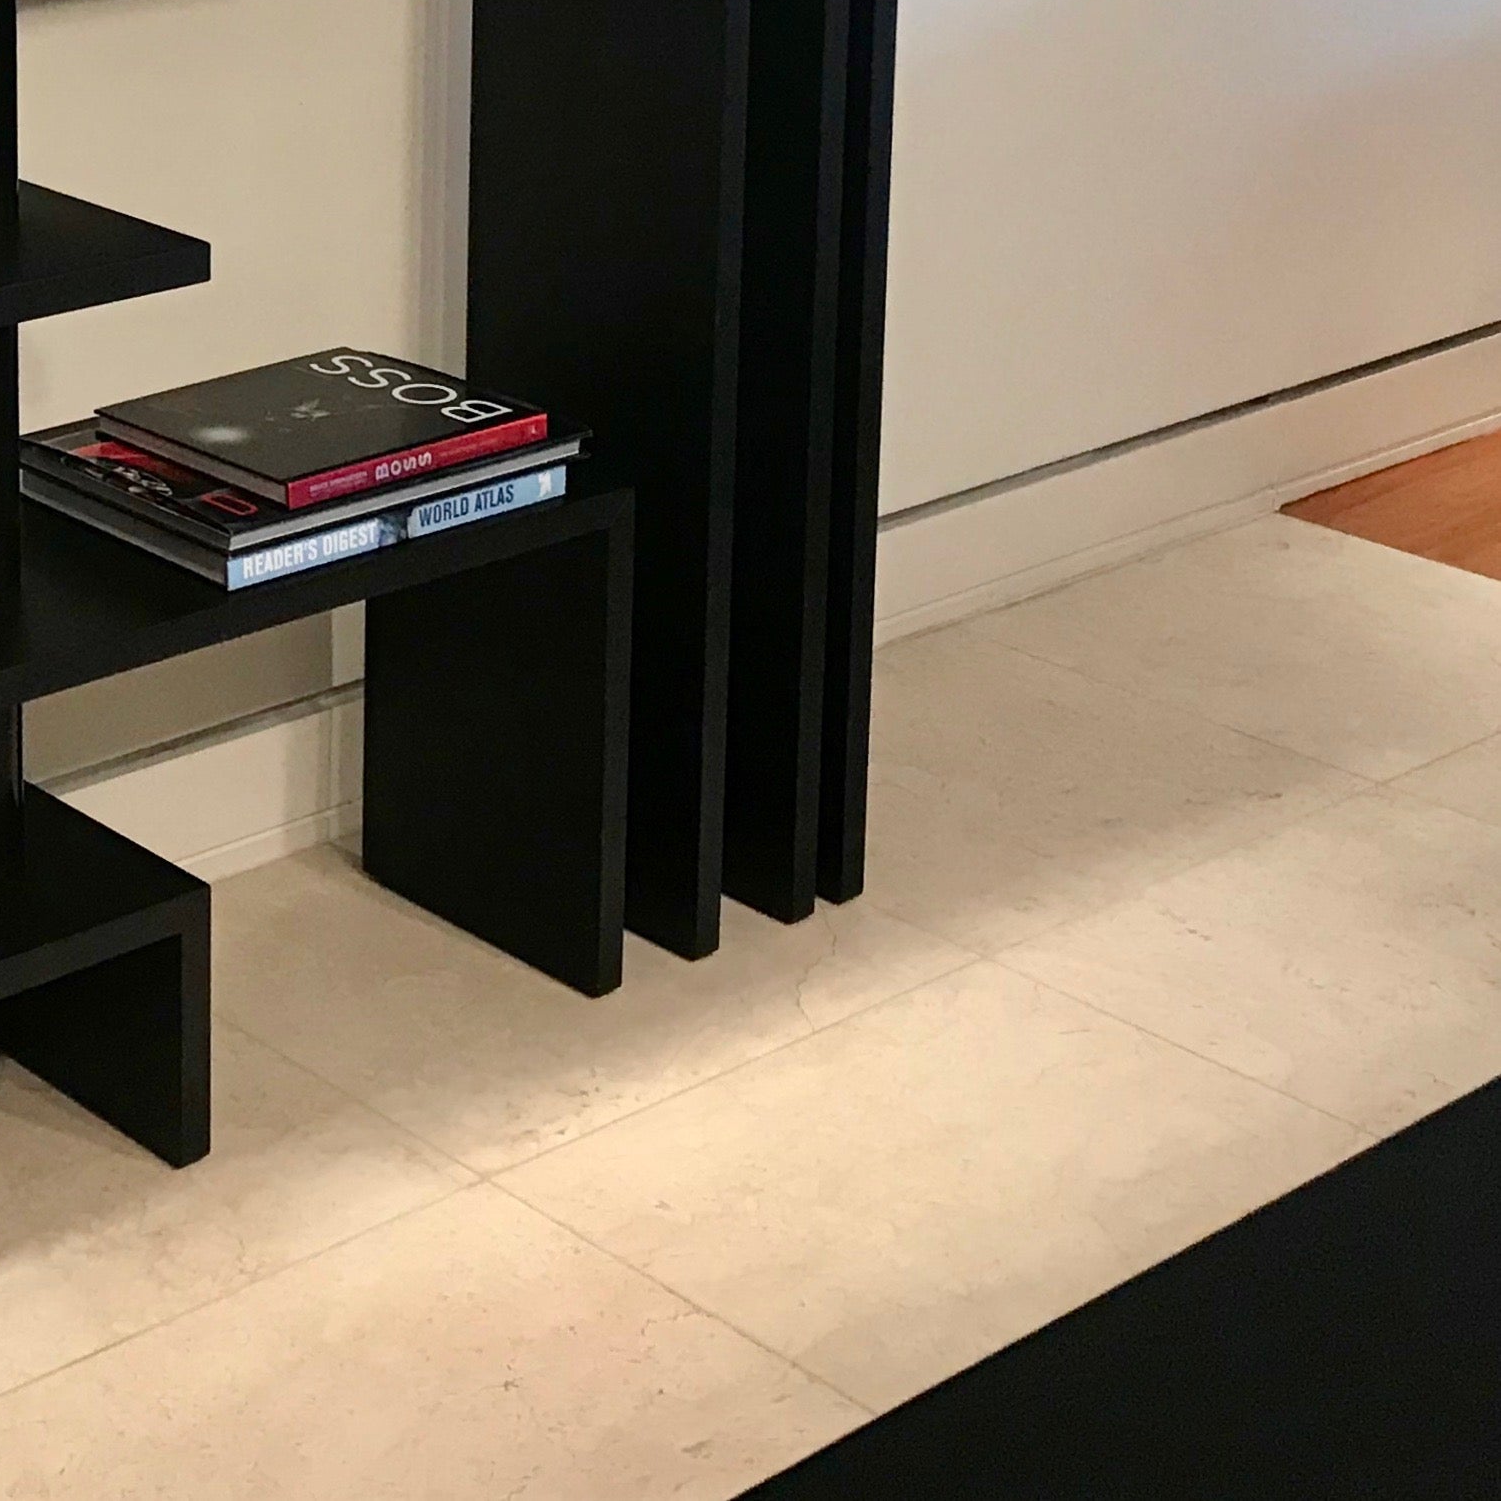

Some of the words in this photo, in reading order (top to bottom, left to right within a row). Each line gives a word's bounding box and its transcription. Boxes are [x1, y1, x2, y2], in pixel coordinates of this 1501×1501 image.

[309, 355, 512, 423] BOSS
[375, 451, 432, 480] BOSS
[242, 538, 317, 579] READER'S
[323, 524, 378, 555] DIGEST
[418, 498, 469, 526] WORLD
[474, 484, 514, 511] ATLAS
